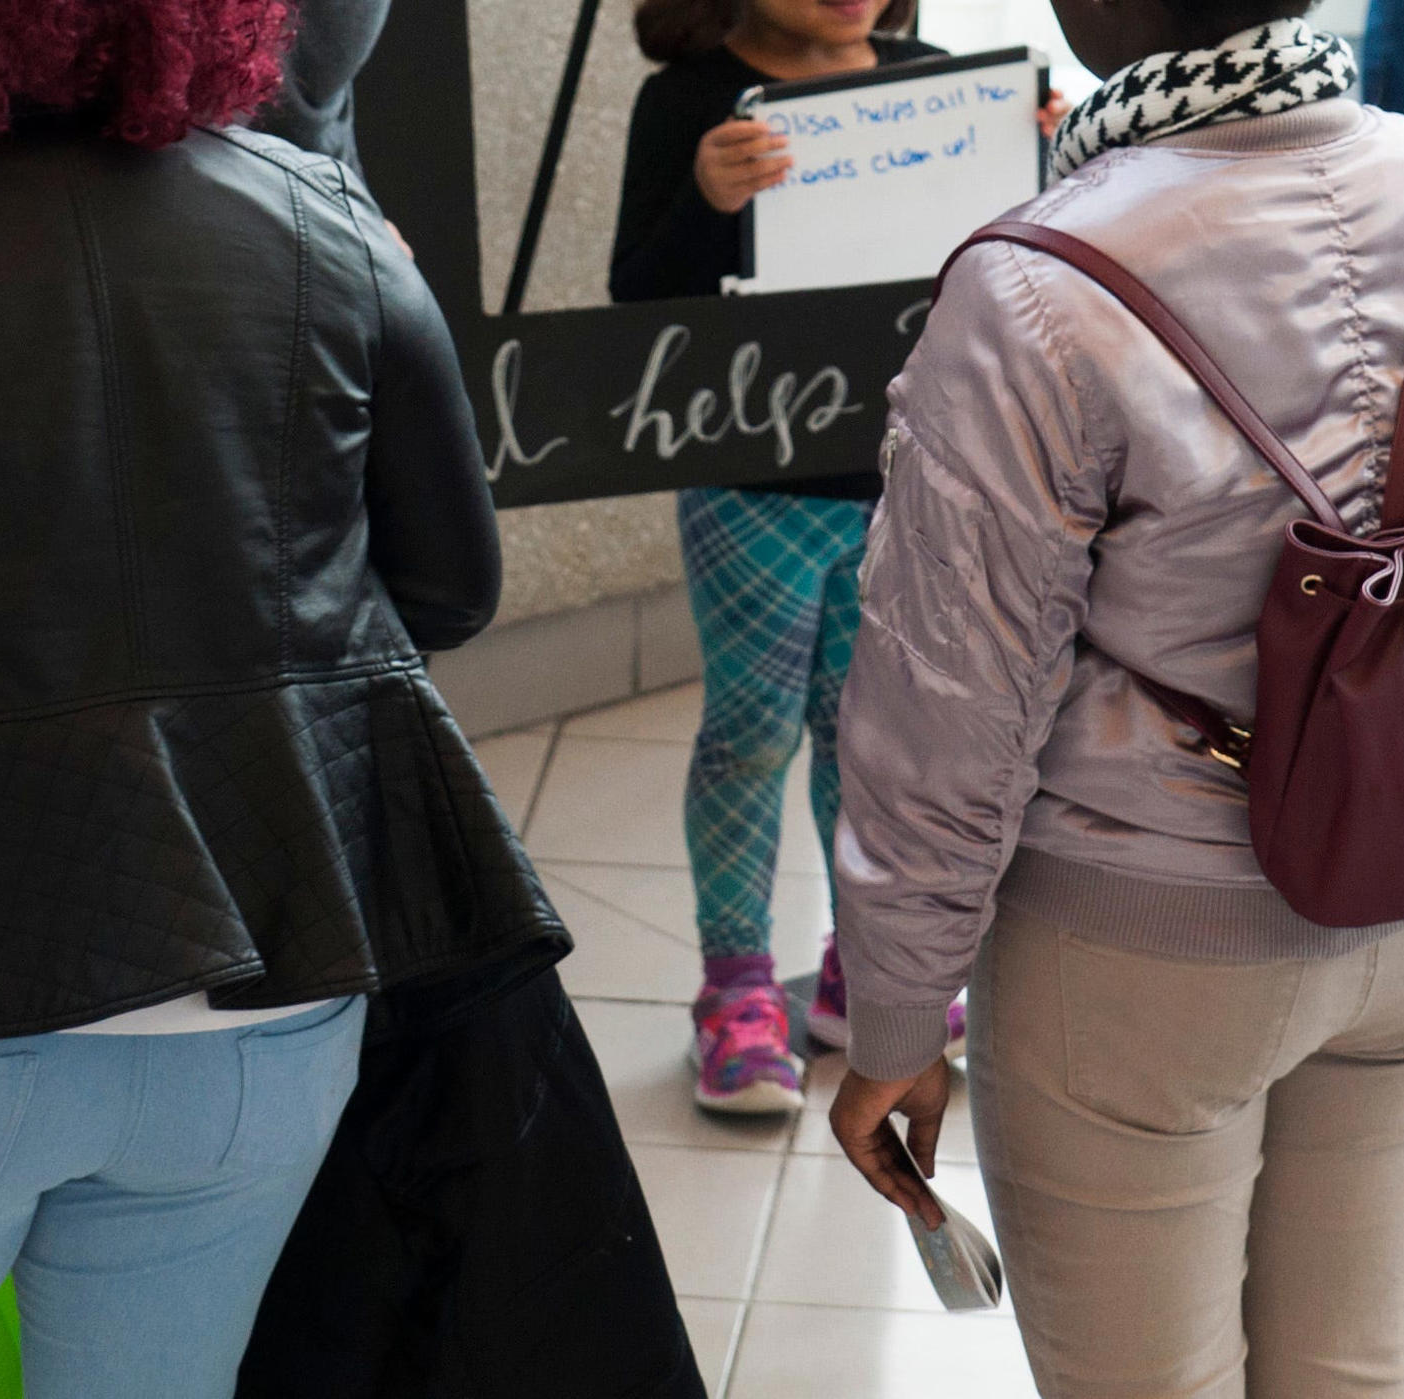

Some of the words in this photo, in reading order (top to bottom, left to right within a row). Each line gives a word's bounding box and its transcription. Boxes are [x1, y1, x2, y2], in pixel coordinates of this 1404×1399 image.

[852, 98, 917, 124] helps
[925, 86, 966, 114] all
[608, 323, 864, 468] helps
